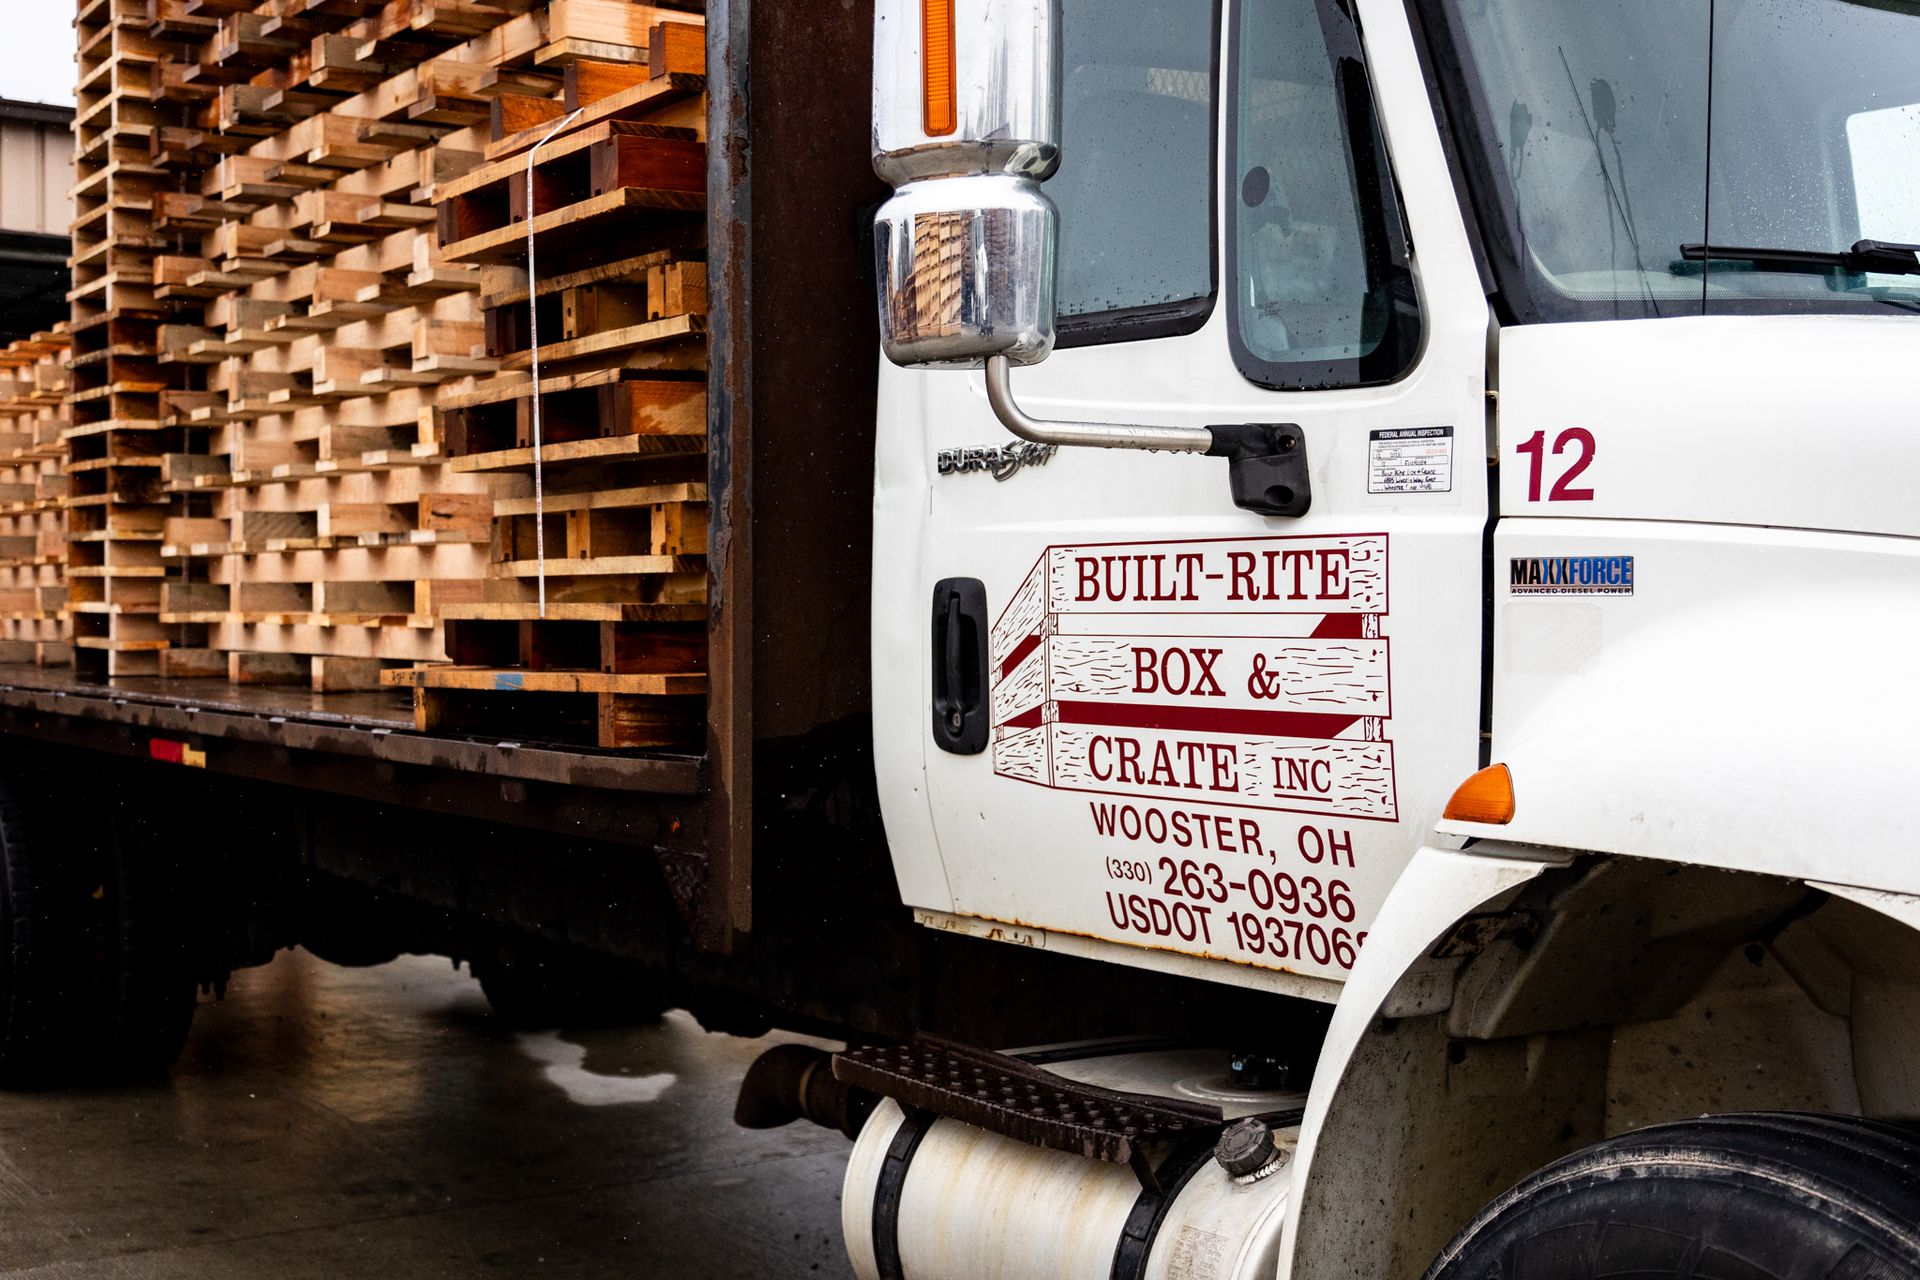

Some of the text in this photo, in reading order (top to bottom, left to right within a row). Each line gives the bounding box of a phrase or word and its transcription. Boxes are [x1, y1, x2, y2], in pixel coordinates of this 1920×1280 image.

[1417, 429, 1444, 437] INSPECTION
[1515, 427, 1596, 502] 12
[1074, 548, 1351, 602] BUILT-RITE
[1510, 556, 1632, 585] MAXXFORCE
[1131, 646, 1281, 700] BOX &
[1088, 735, 1332, 794] CRATE INC
[1089, 801, 1356, 868] WOOSTER, OH
[1105, 856, 1356, 923] (330) 263-0936
[1105, 891, 1369, 971] USDOT 193706
